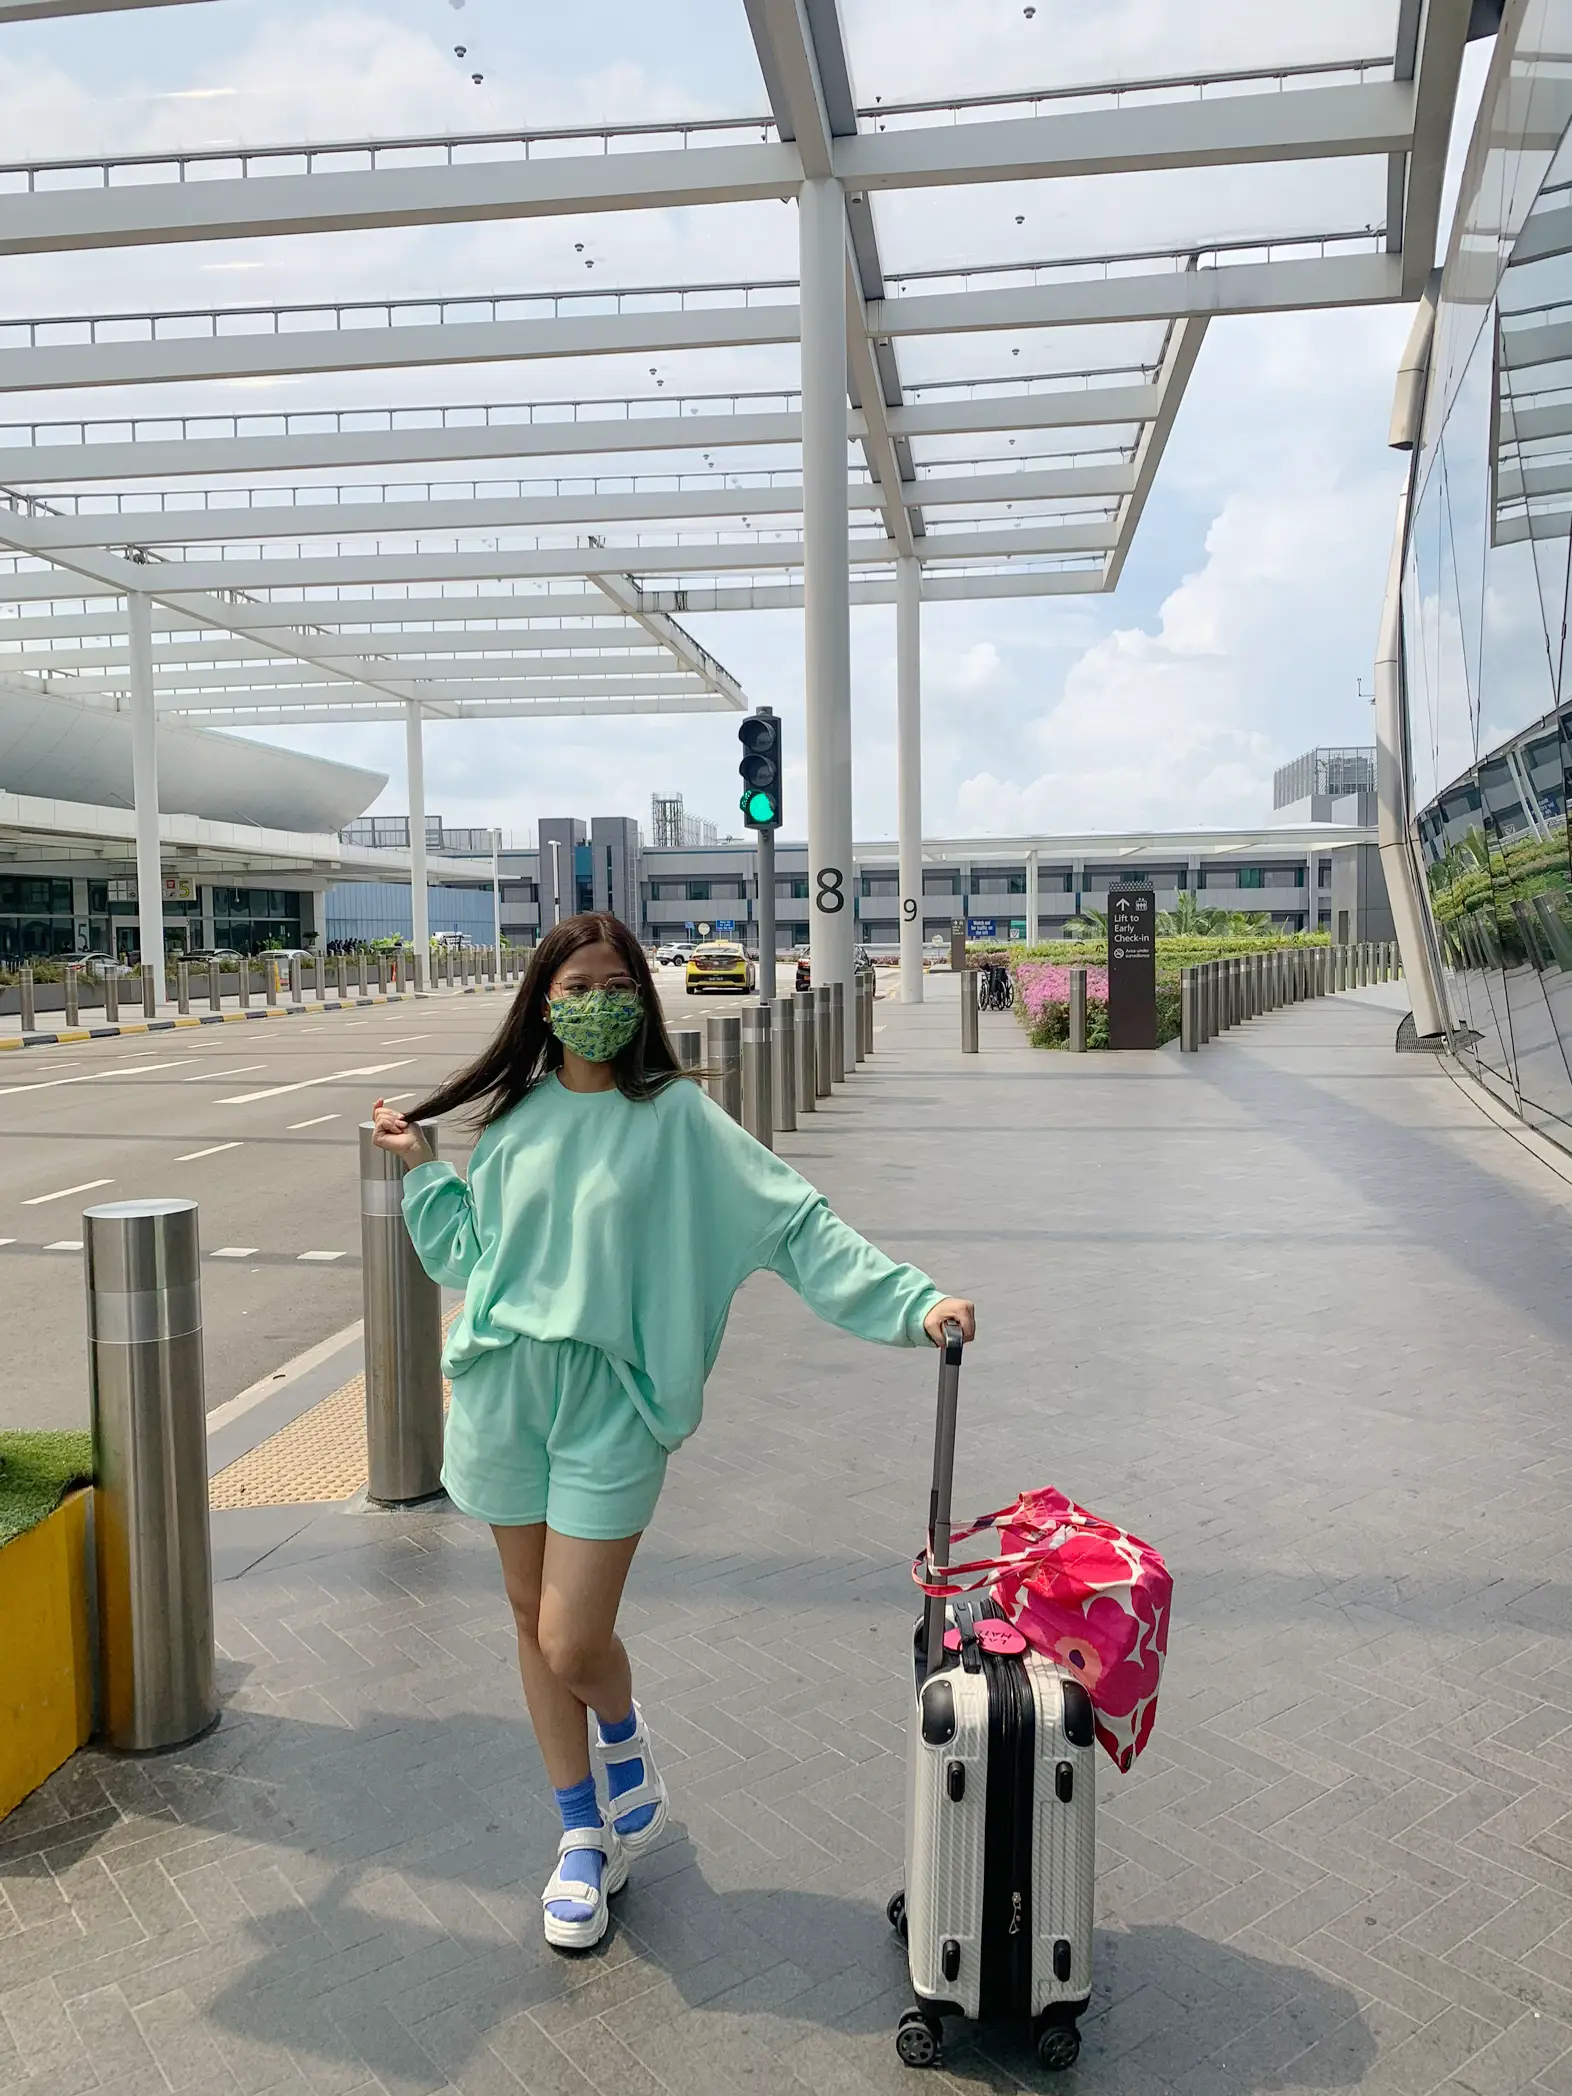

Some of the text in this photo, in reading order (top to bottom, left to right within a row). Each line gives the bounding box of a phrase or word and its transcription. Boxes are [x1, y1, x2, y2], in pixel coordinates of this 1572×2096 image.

[178, 880, 190, 898] 5
[816, 867, 844, 914] 8
[903, 898, 918, 922] 9
[1114, 914, 1139, 922] Lift to
[78, 923, 88, 951] 5
[1114, 924, 1134, 934] Early
[1114, 934, 1150, 942] Check-in
